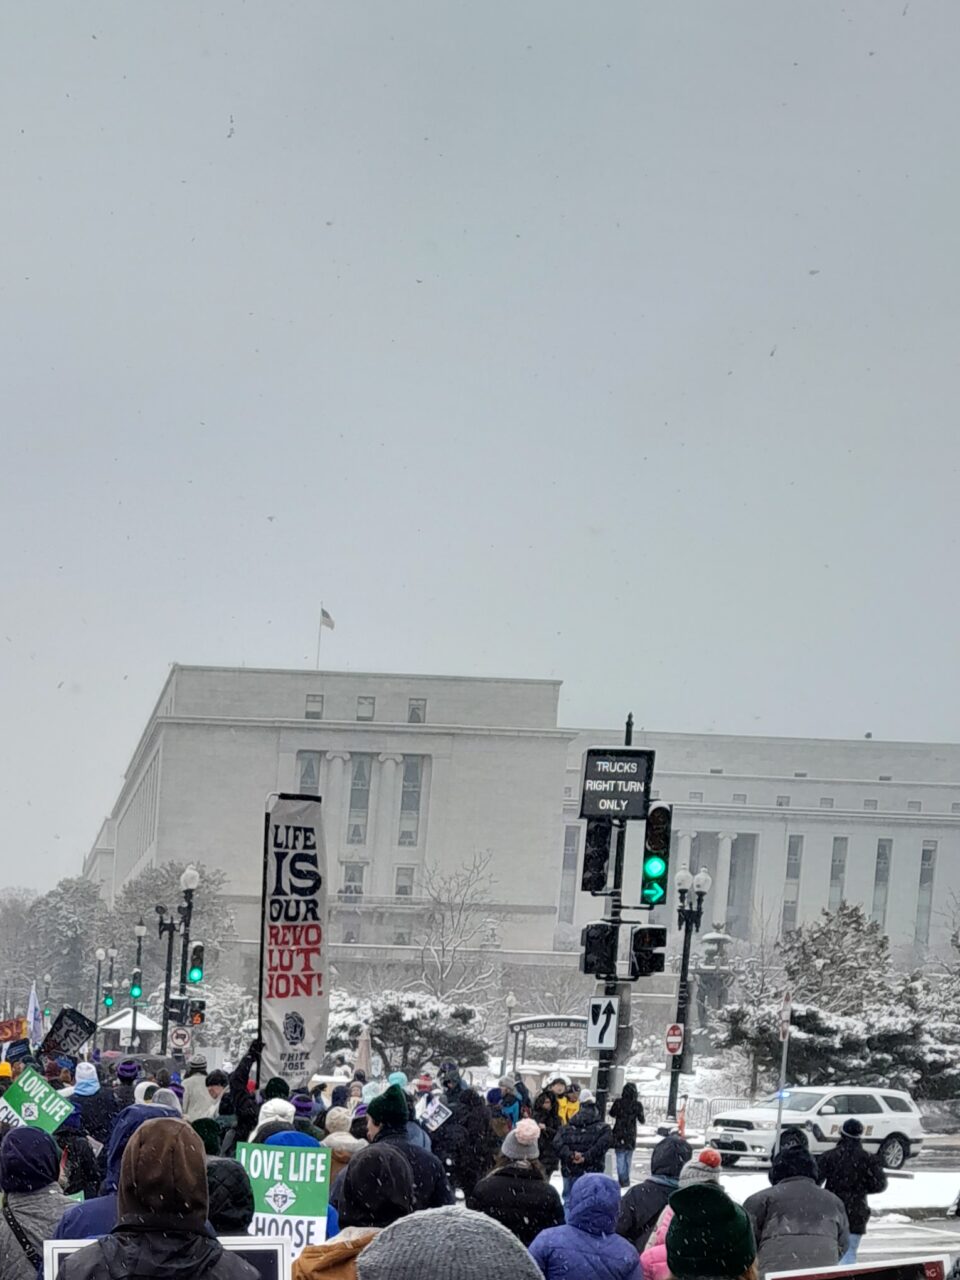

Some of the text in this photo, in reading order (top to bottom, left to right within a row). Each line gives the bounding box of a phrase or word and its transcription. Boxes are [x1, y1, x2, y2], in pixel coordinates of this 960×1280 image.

[596, 761, 638, 773] TRUCKS
[585, 780, 645, 792] RIGHT TURN
[598, 799, 629, 811] ONLY
[273, 824, 317, 850] LIFE
[271, 851, 322, 897] IS
[269, 899, 322, 922] OUR
[268, 923, 322, 946] REVO
[267, 947, 321, 972] LUT
[266, 973, 323, 998] ION!
[18, 1070, 71, 1122] LOVE LIFE
[241, 1148, 327, 1183] LOVE LIFE
[255, 1217, 316, 1248] HOOSE
